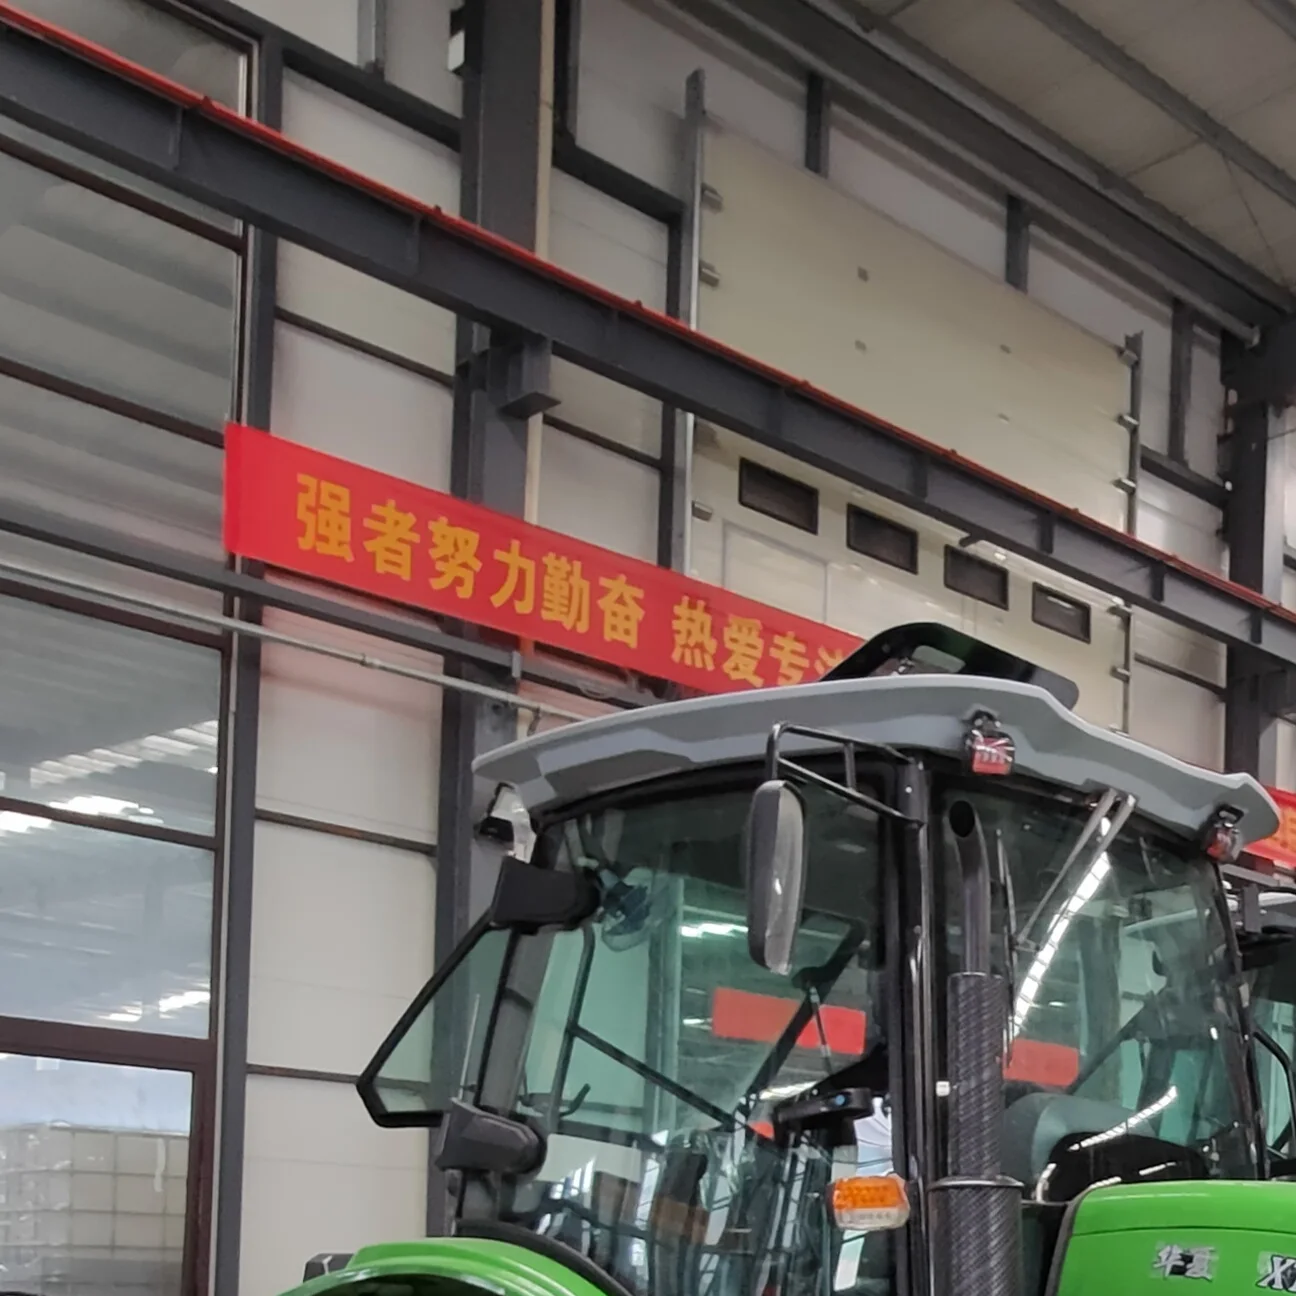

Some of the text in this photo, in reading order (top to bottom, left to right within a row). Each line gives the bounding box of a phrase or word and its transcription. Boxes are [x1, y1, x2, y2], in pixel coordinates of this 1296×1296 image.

[297, 472, 646, 649] 强者努力勤奋
